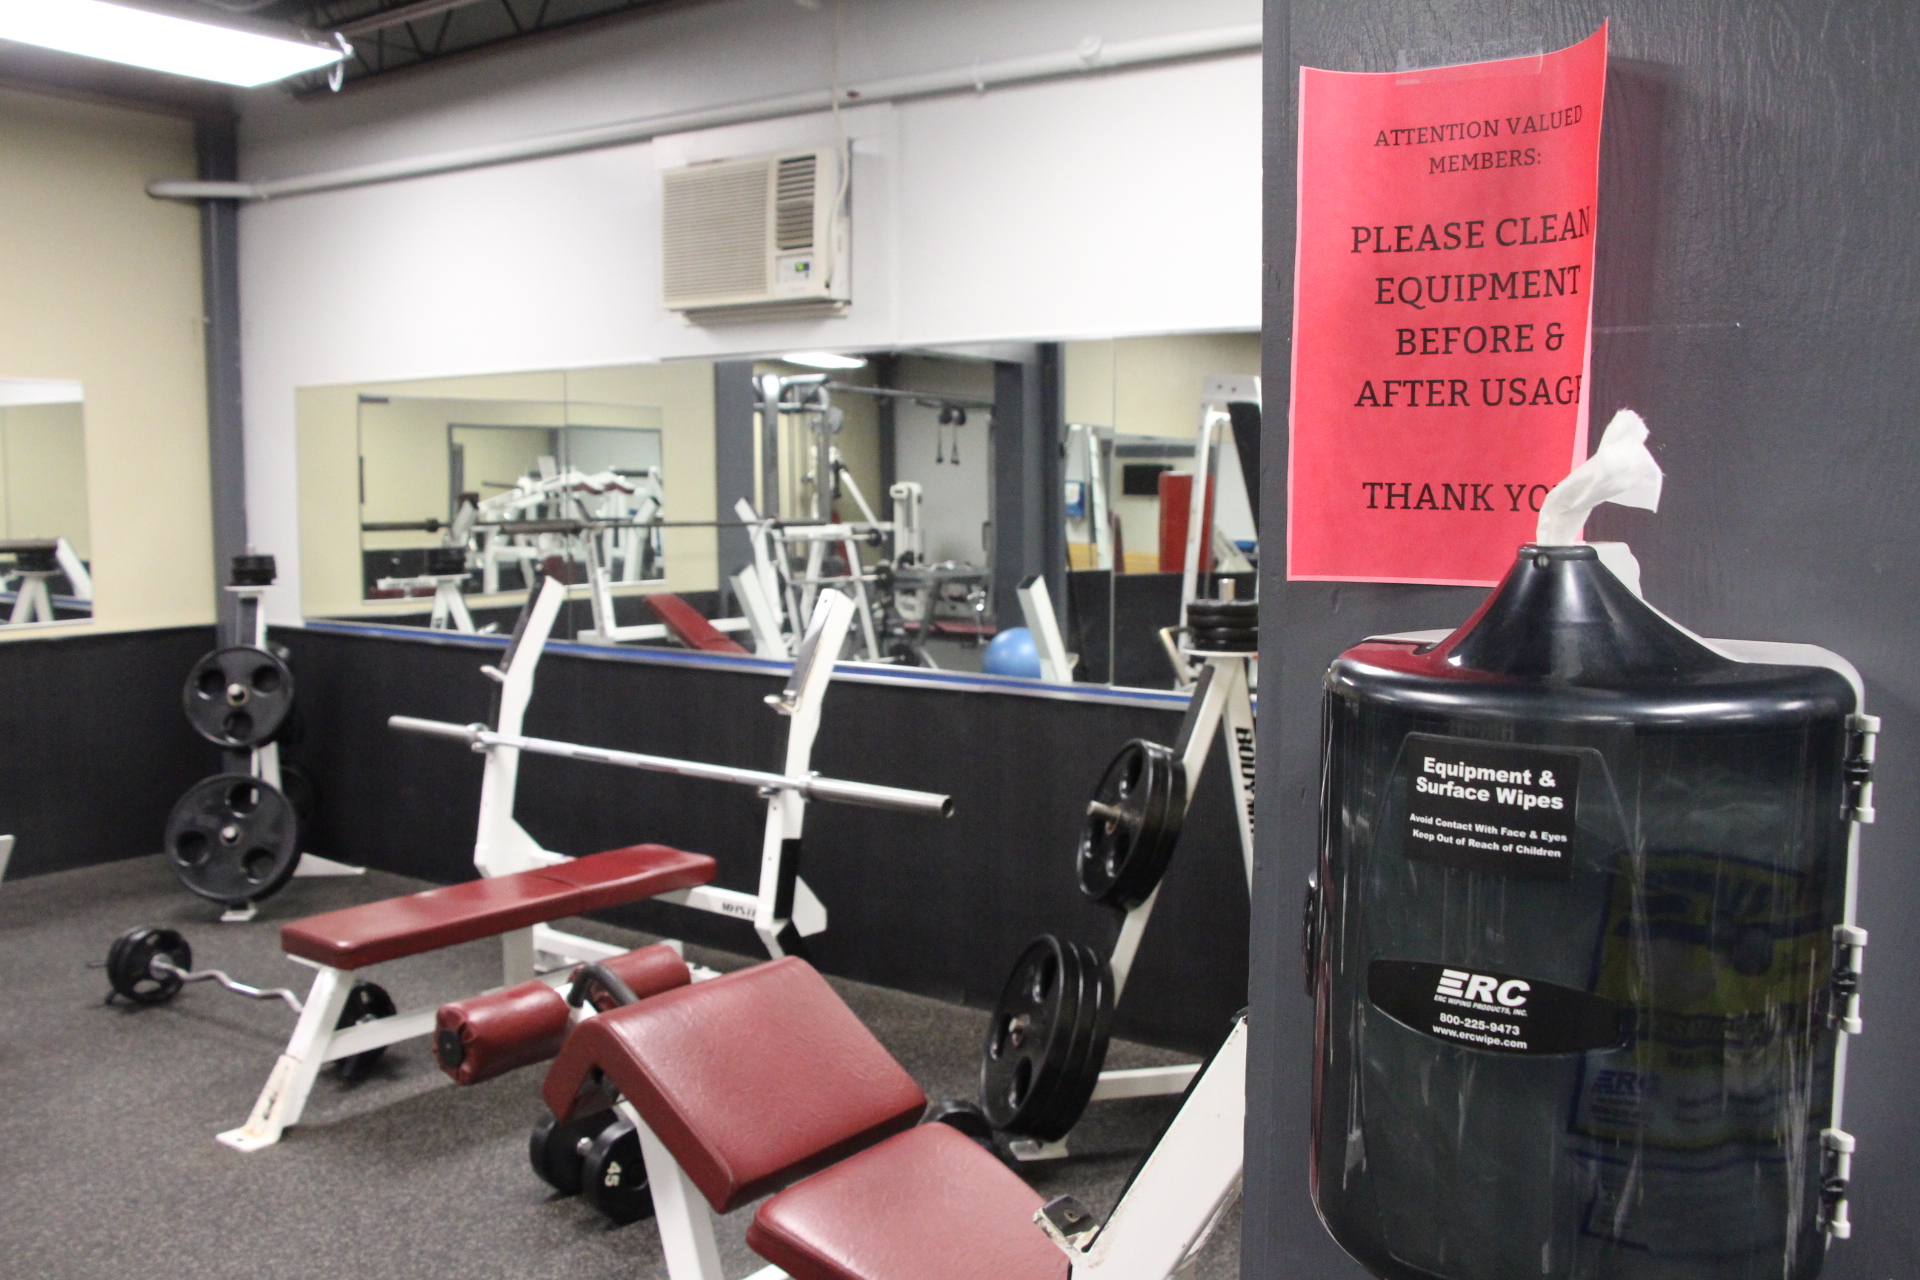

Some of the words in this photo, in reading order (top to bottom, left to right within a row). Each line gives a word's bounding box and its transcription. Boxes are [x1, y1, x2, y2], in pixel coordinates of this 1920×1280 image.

[1374, 119, 1500, 147] ATTENTION
[1506, 104, 1583, 136] VALUED
[1428, 148, 1542, 174] MEMBERS:
[1350, 220, 1485, 254] PLEASE
[1495, 206, 1591, 248] CLEAN
[1375, 265, 1581, 310] EQUIPMENT
[1395, 323, 1534, 355] BEFORE
[1544, 322, 1565, 351] &
[1354, 380, 1470, 407] AFTER
[1362, 482, 1494, 512] THANK
[1504, 483, 1557, 512] YO
[1423, 756, 1532, 786] Equipment
[1538, 770, 1556, 787] &
[1416, 776, 1490, 802] Surface
[1496, 787, 1564, 810] Wipes
[1409, 813, 1434, 826] Avoid
[1435, 818, 1473, 832] Contact
[1474, 823, 1499, 836] With
[1500, 827, 1527, 839] Face
[1529, 830, 1538, 840] &
[1541, 831, 1568, 843] Eyes
[1412, 829, 1435, 842] Keep
[1436, 834, 1454, 845] Out
[1455, 838, 1466, 846] of
[1468, 839, 1500, 851] Reach
[1502, 844, 1513, 852] of
[1516, 845, 1562, 858] Children
[1436, 968, 1531, 1007] ERC
[1434, 994, 1447, 1003] ERC
[1447, 998, 1472, 1009] WIPING
[1472, 1002, 1512, 1015] PRODUCTS,
[1512, 1008, 1528, 1017] INC.
[1432, 1025, 1528, 1049] www.ercwipe.com
[1439, 1012, 1520, 1036] 800-225-9473
[604, 1161, 622, 1187] 45
